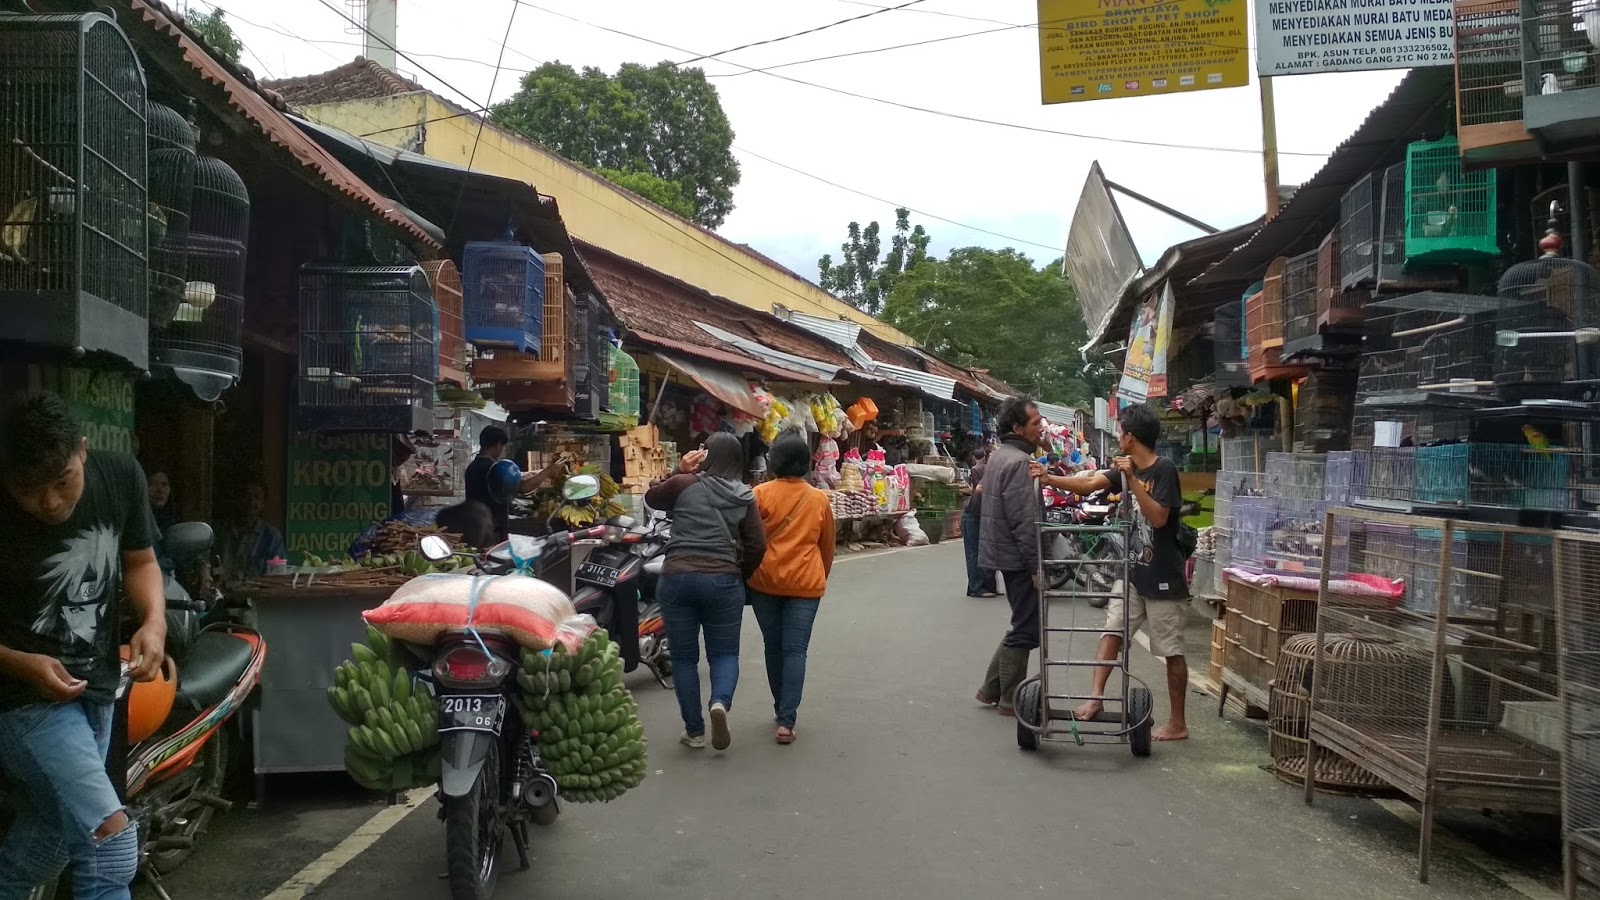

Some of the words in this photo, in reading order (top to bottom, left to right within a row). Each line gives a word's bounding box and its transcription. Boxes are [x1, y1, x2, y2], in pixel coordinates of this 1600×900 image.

[1105, 5, 1180, 17] BRAWIJAYA
[1269, 0, 1347, 14] MENYEDIAKAN
[1067, 21, 1097, 29] BIRD
[1102, 17, 1137, 26] SHOP
[1142, 15, 1151, 23] &
[1156, 13, 1179, 21] PET
[1184, 10, 1219, 19] SHOP
[1200, 16, 1234, 25] HAMSTER
[1272, 15, 1350, 30] MENYEDIAKAN
[1354, 12, 1388, 25] MURAI
[1392, 11, 1419, 23] BATU
[1424, 9, 1453, 21] MEDA
[1283, 31, 1361, 47] MENYEDIAKAN
[1365, 29, 1401, 42] SEMUA
[1405, 27, 1436, 39] JENIS
[1097, 52, 1137, 60] BRAWIJAYA
[1297, 50, 1320, 59] BPK.
[1323, 48, 1350, 58] ASUN
[1353, 47, 1377, 56] TELP.
[1275, 61, 1313, 70] ALAMAT
[1322, 57, 1362, 67] GADANG
[1365, 56, 1393, 64] GANG
[1396, 54, 1414, 62] 21C
[1177, 66, 1201, 74] DEBIT
[293, 459, 386, 487] KROTO
[289, 501, 388, 520] KRODONG
[288, 532, 357, 552] JANGK
[587, 565, 606, 575] 3114
[609, 570, 619, 579] CL
[444, 698, 482, 713] 2013
